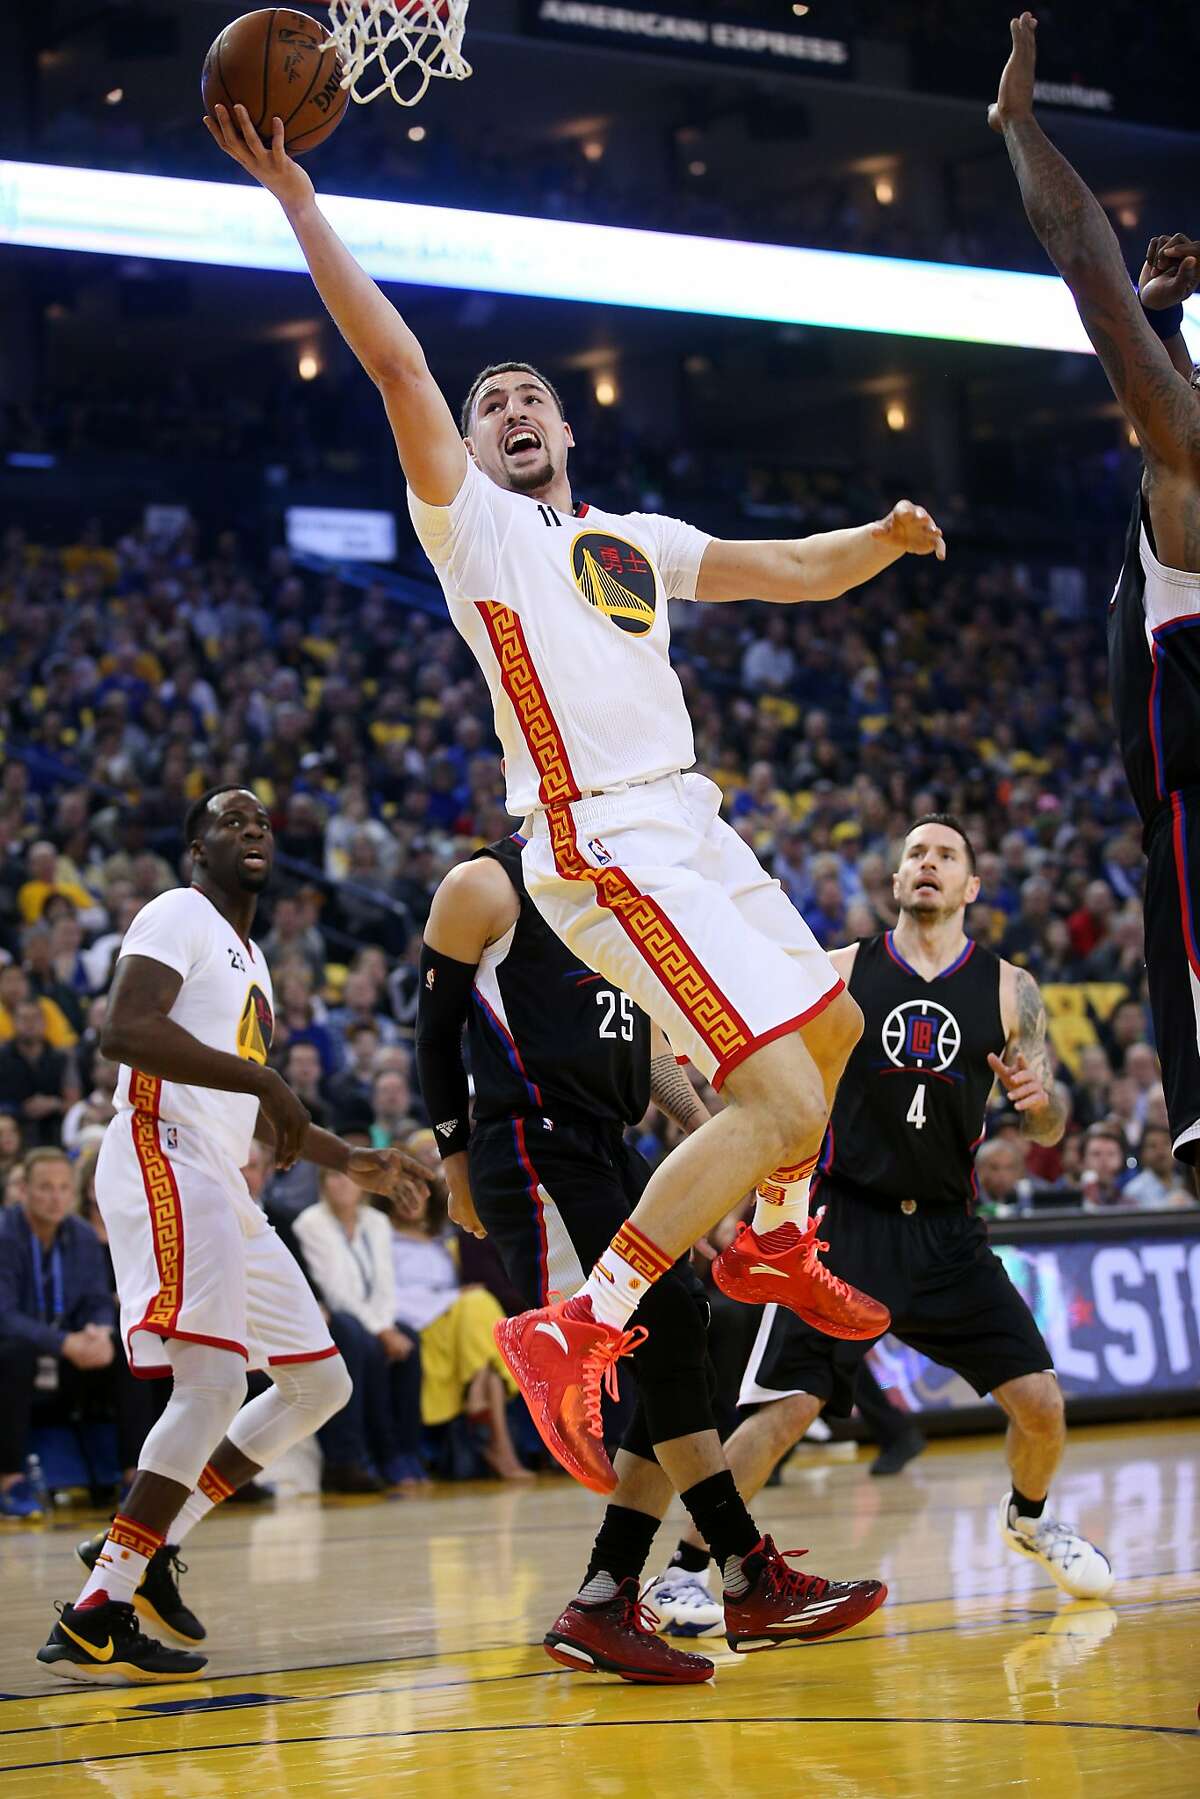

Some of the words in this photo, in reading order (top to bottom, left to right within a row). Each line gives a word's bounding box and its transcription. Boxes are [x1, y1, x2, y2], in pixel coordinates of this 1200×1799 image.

[540, 0, 707, 44] AMERICAN
[711, 24, 848, 64] EXPRESS
[537, 504, 562, 527] 11
[596, 990, 634, 1042] 25
[906, 1084, 927, 1130] 4
